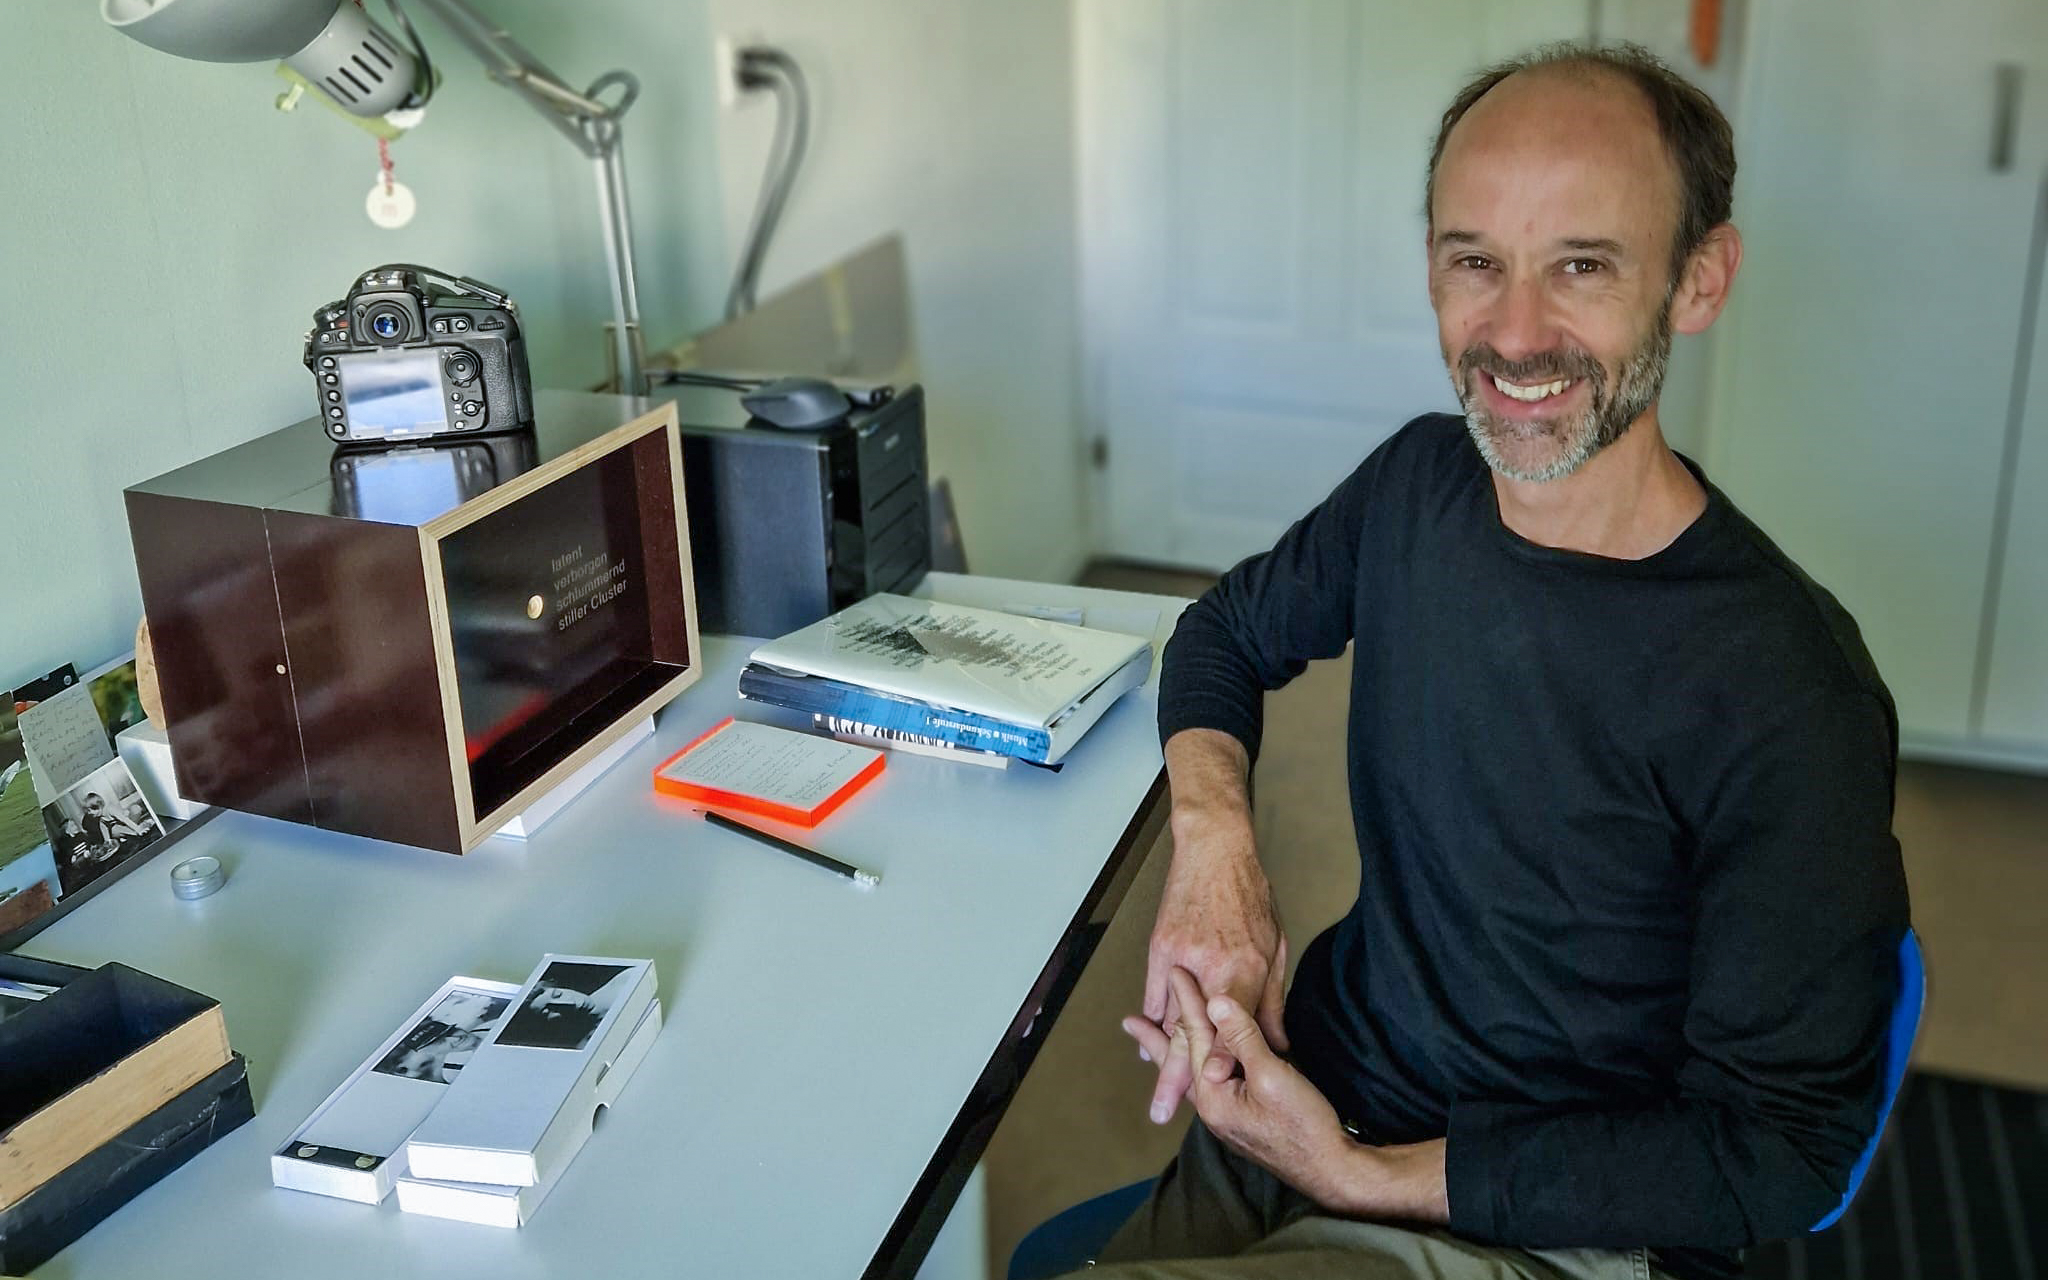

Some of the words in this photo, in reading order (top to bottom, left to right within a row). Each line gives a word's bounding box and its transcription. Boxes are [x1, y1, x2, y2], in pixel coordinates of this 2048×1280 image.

[551, 544, 583, 573] latent
[556, 558, 625, 612] schlummernd
[558, 603, 588, 631] stiller
[590, 579, 627, 609] Cluster
[932, 717, 992, 739] Sekundarstufe
[1000, 731, 1029, 747] Musik
